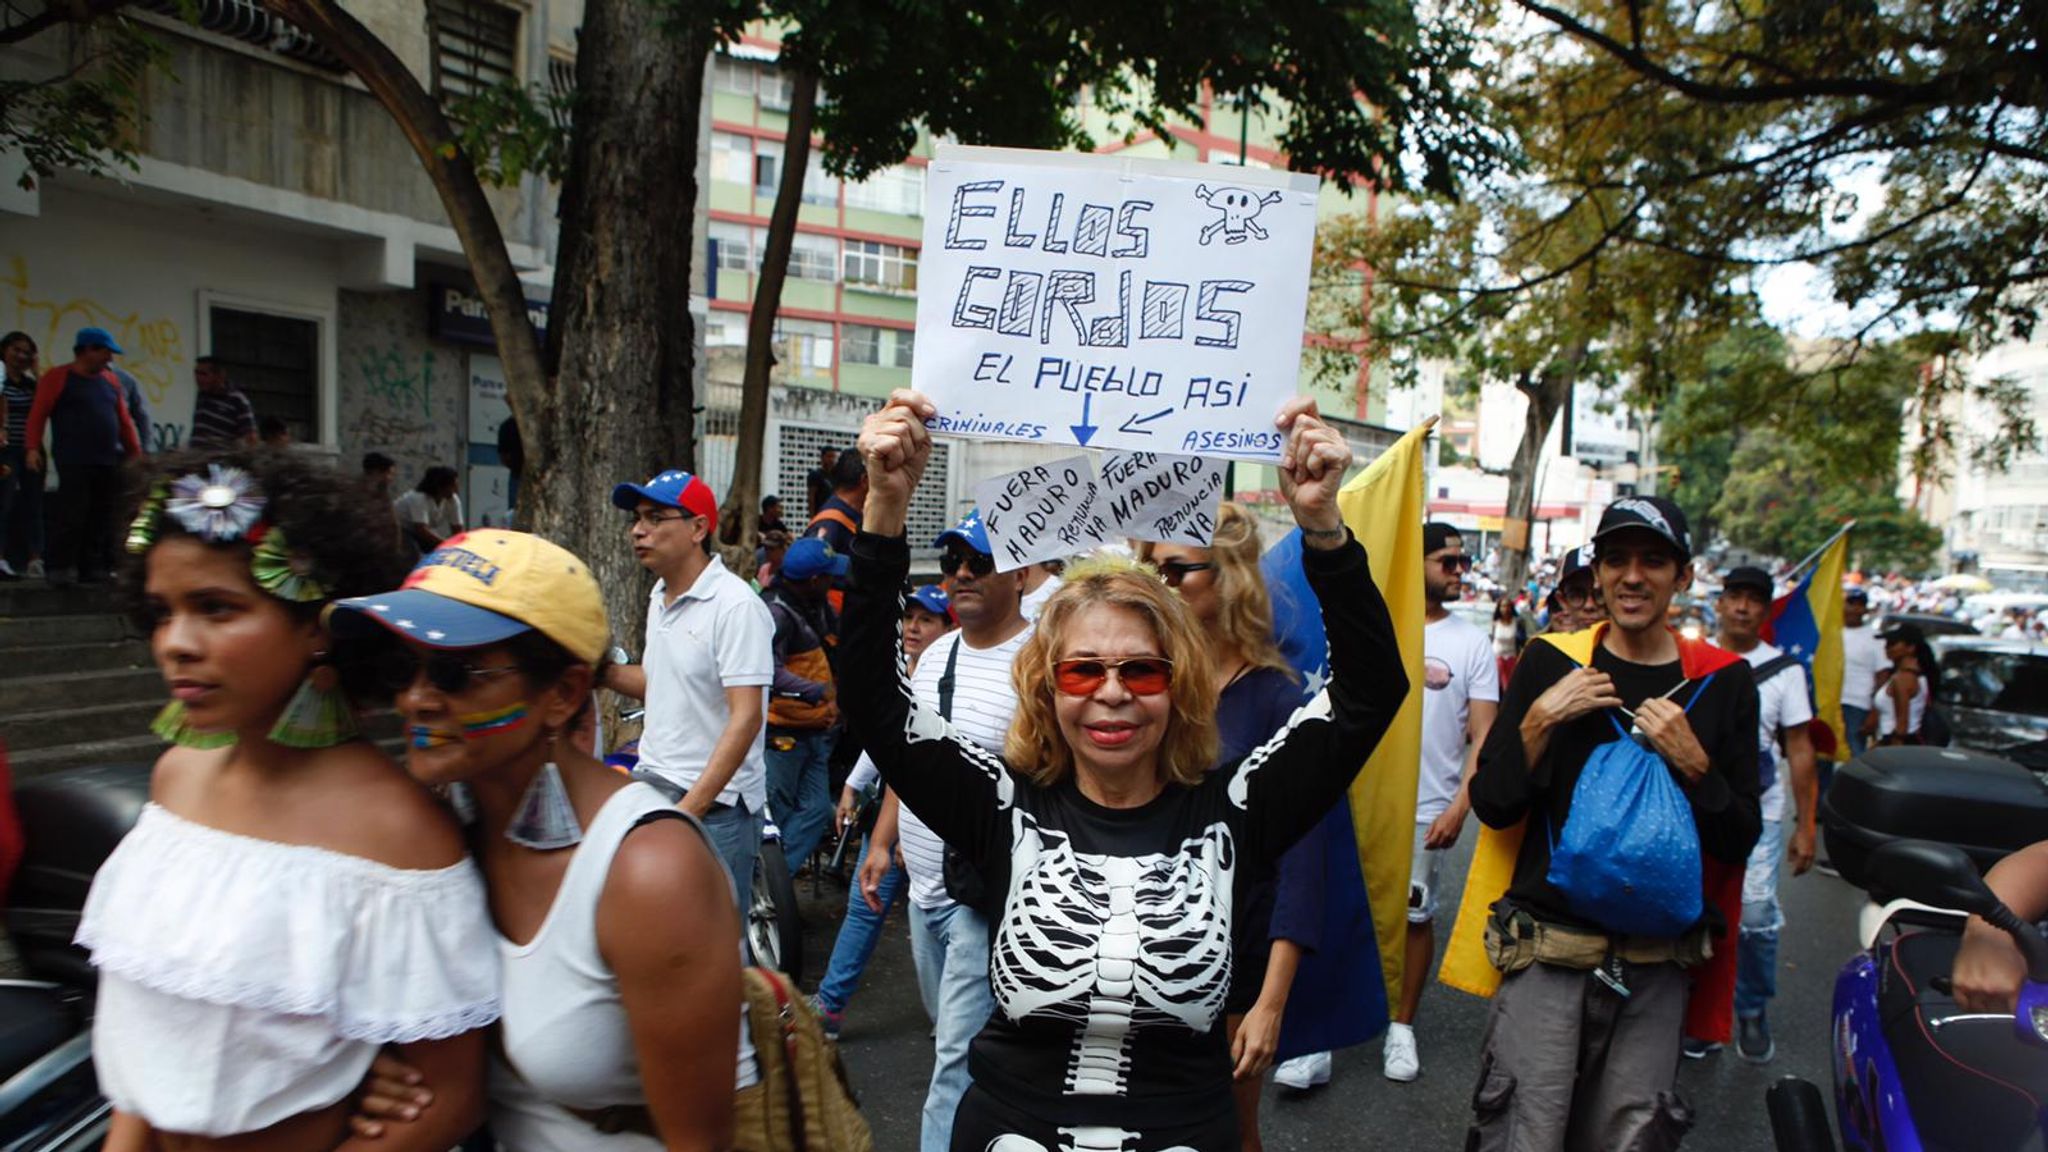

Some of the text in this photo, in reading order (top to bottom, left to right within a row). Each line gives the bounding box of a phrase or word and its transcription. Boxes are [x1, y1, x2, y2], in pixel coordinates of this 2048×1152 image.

[945, 180, 1154, 258] ELLOS
[973, 353, 1013, 384] EL
[1101, 451, 1158, 491] FUERA
[1110, 456, 1203, 529] MADURO
[986, 464, 1051, 535] FUERA
[1006, 468, 1079, 565] MADURO
[1084, 515, 1108, 543] YA
[1183, 512, 1214, 546] YA
